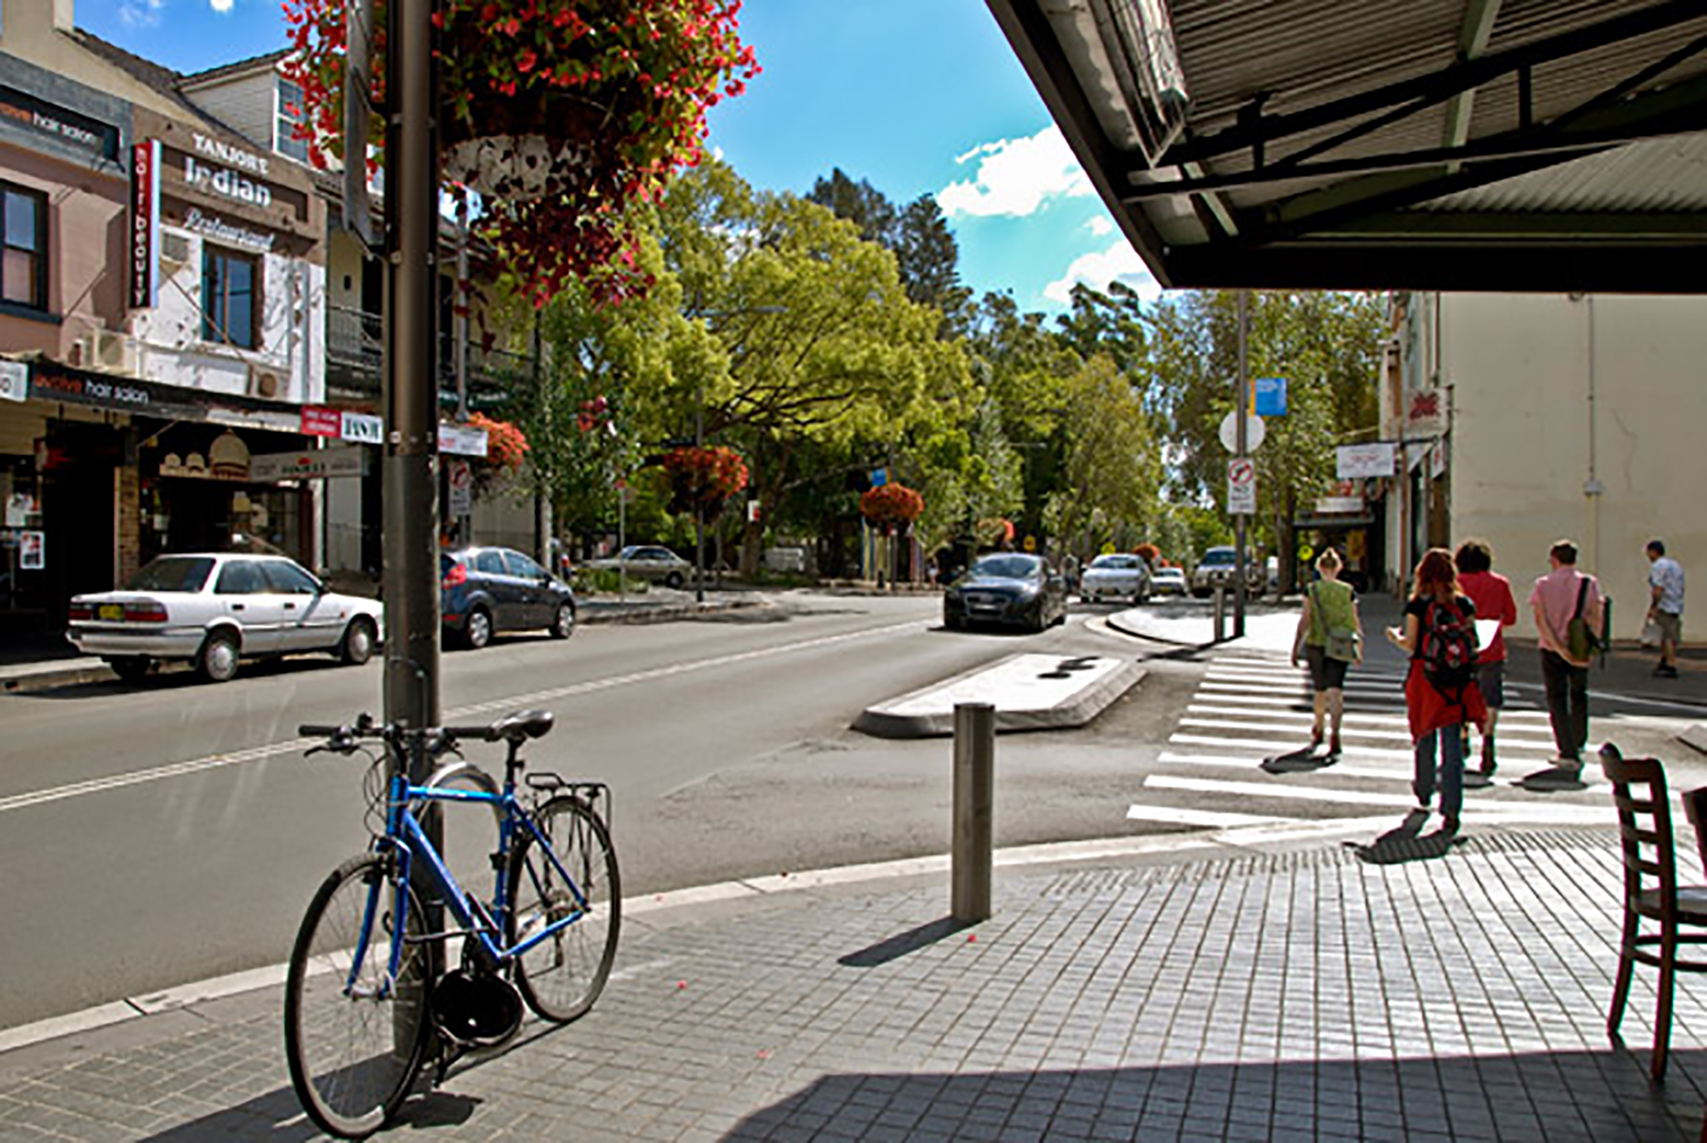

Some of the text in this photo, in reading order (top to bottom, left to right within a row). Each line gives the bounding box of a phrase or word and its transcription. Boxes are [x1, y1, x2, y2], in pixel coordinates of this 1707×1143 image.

[33, 111, 60, 132] hair
[60, 123, 101, 146] salon
[192, 132, 268, 175] TANJORE
[184, 156, 271, 206] Indian
[85, 377, 112, 398] hair
[113, 385, 149, 405] salon
